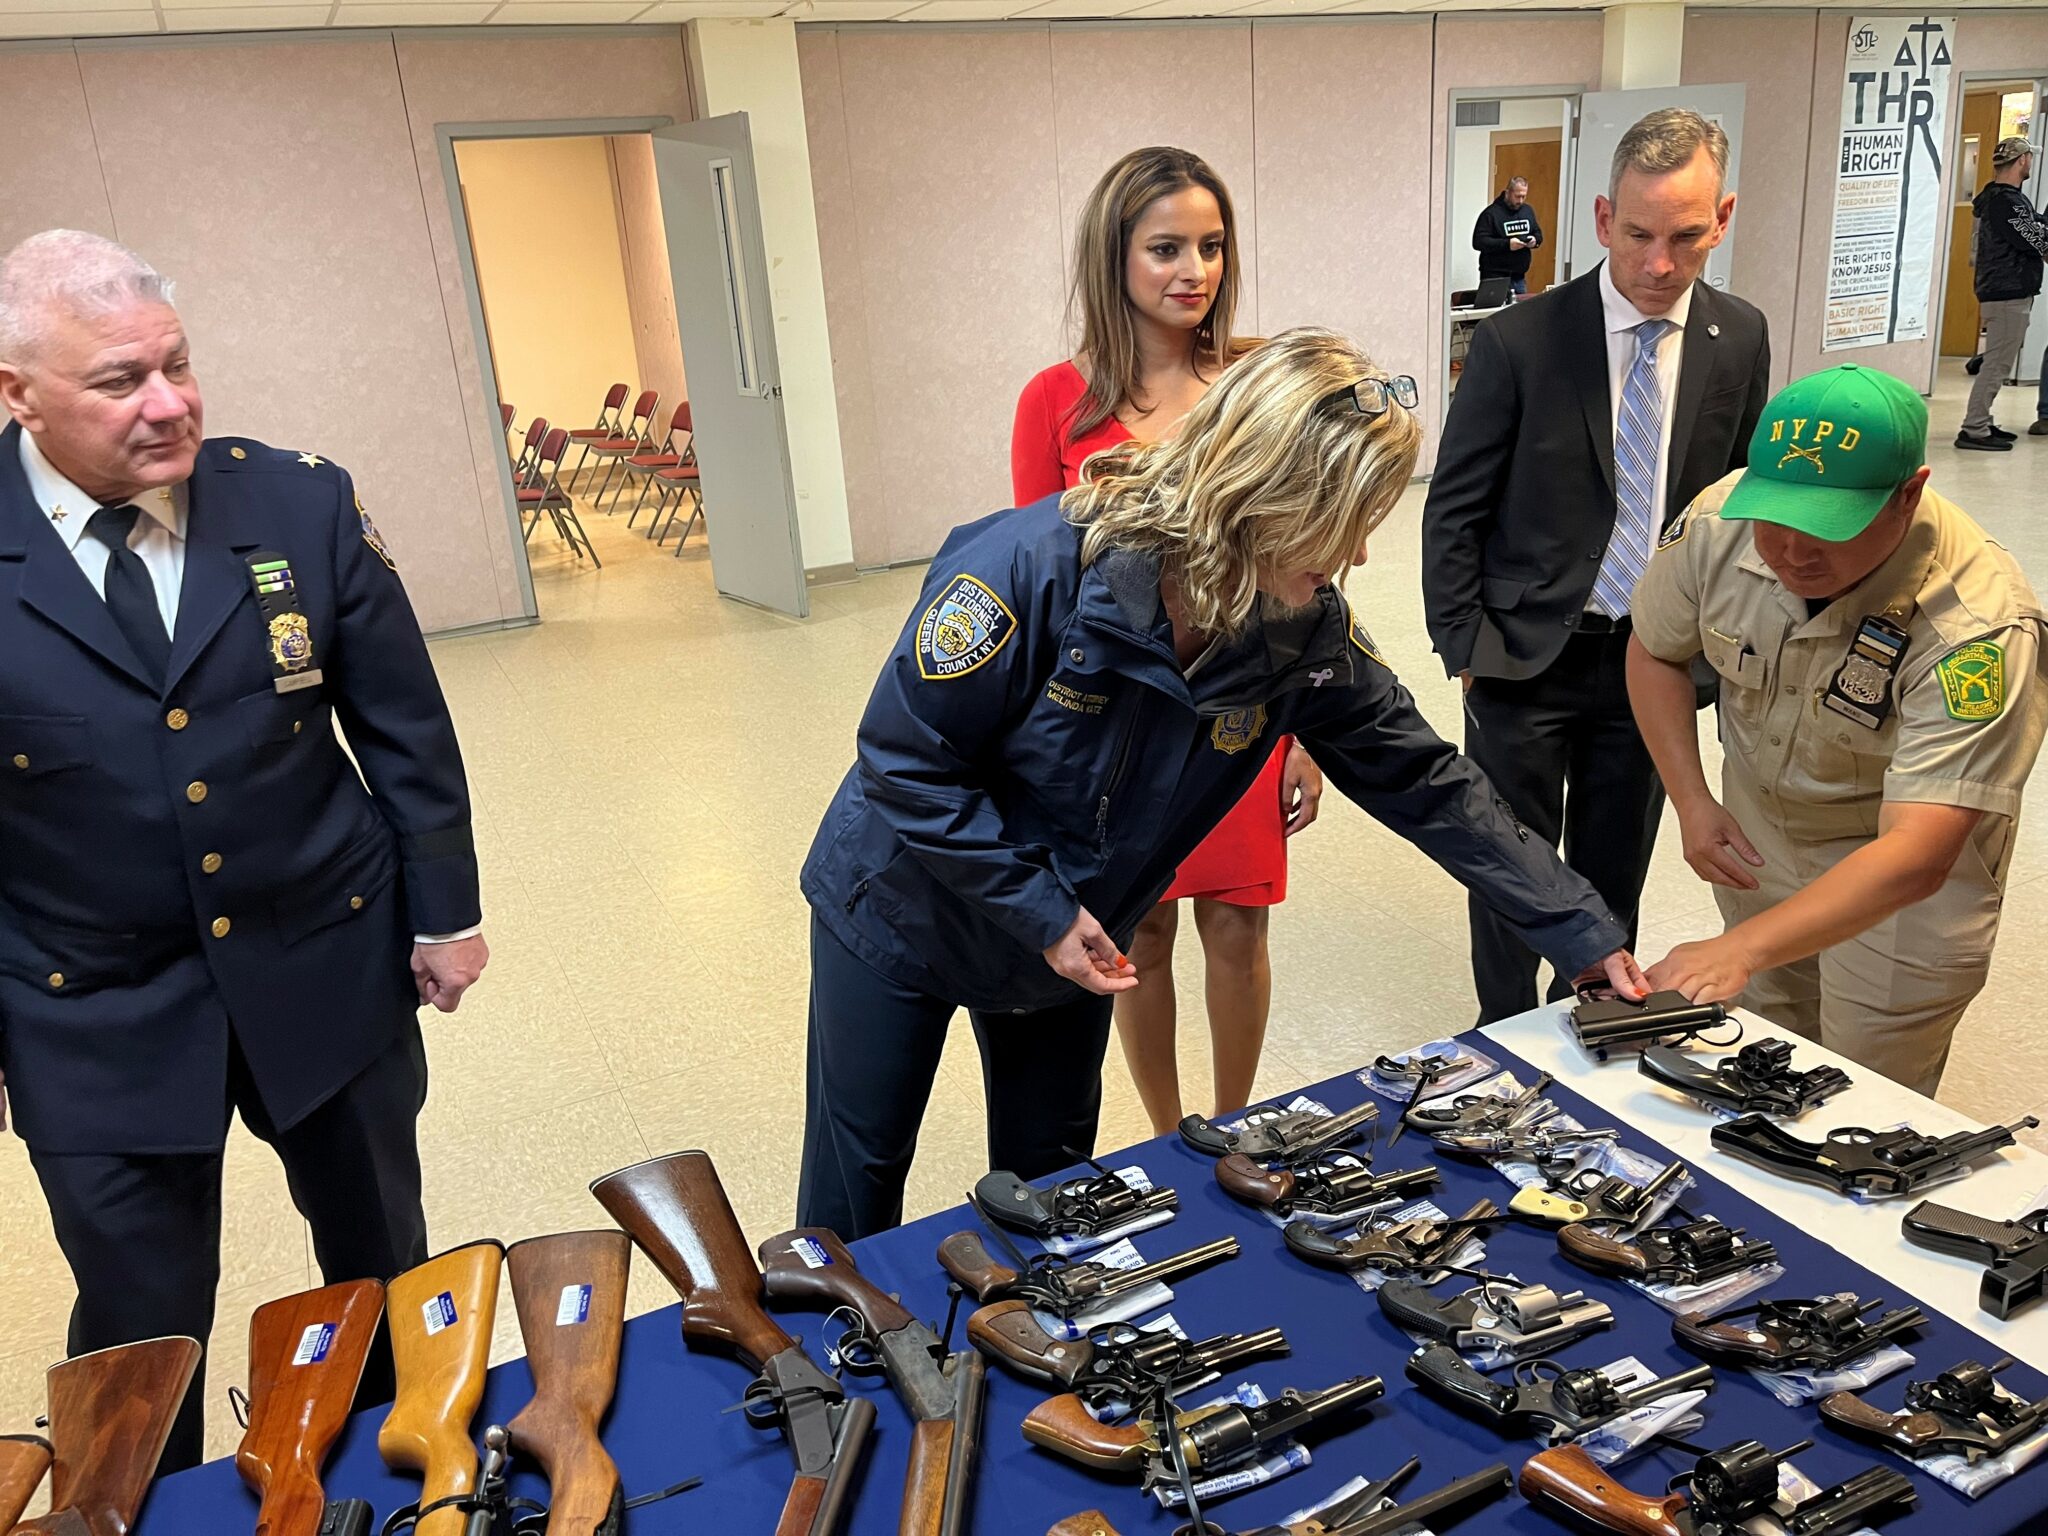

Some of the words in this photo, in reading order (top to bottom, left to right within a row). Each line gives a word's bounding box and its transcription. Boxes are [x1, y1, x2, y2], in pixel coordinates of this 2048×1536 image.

[1852, 134, 1903, 151] HUMAN
[1851, 151, 1902, 172] RIGHT
[1839, 181, 1872, 193] QUALITY
[1872, 180, 1884, 190] OF
[1883, 178, 1899, 189] LIFE
[1833, 254, 1850, 266] THE
[1852, 252, 1879, 264] RIGHT
[1880, 251, 1892, 261] TO
[1831, 265, 1862, 279] KNOW
[1863, 262, 1892, 275] JESUS
[1837, 278, 1849, 286] THE
[1849, 276, 1873, 285] CRUCIAL
[1828, 307, 1856, 320] BASIC
[1826, 326, 1858, 339] HUMAN
[1769, 418, 1861, 452] NYPD
[958, 580, 1004, 621] DISTRICT
[948, 590, 999, 633] ATTORNEY
[920, 608, 938, 654] QUEENS
[936, 650, 983, 675] COUNTY,
[979, 637, 996, 655] NY
[1046, 689, 1084, 713] MELINDA
